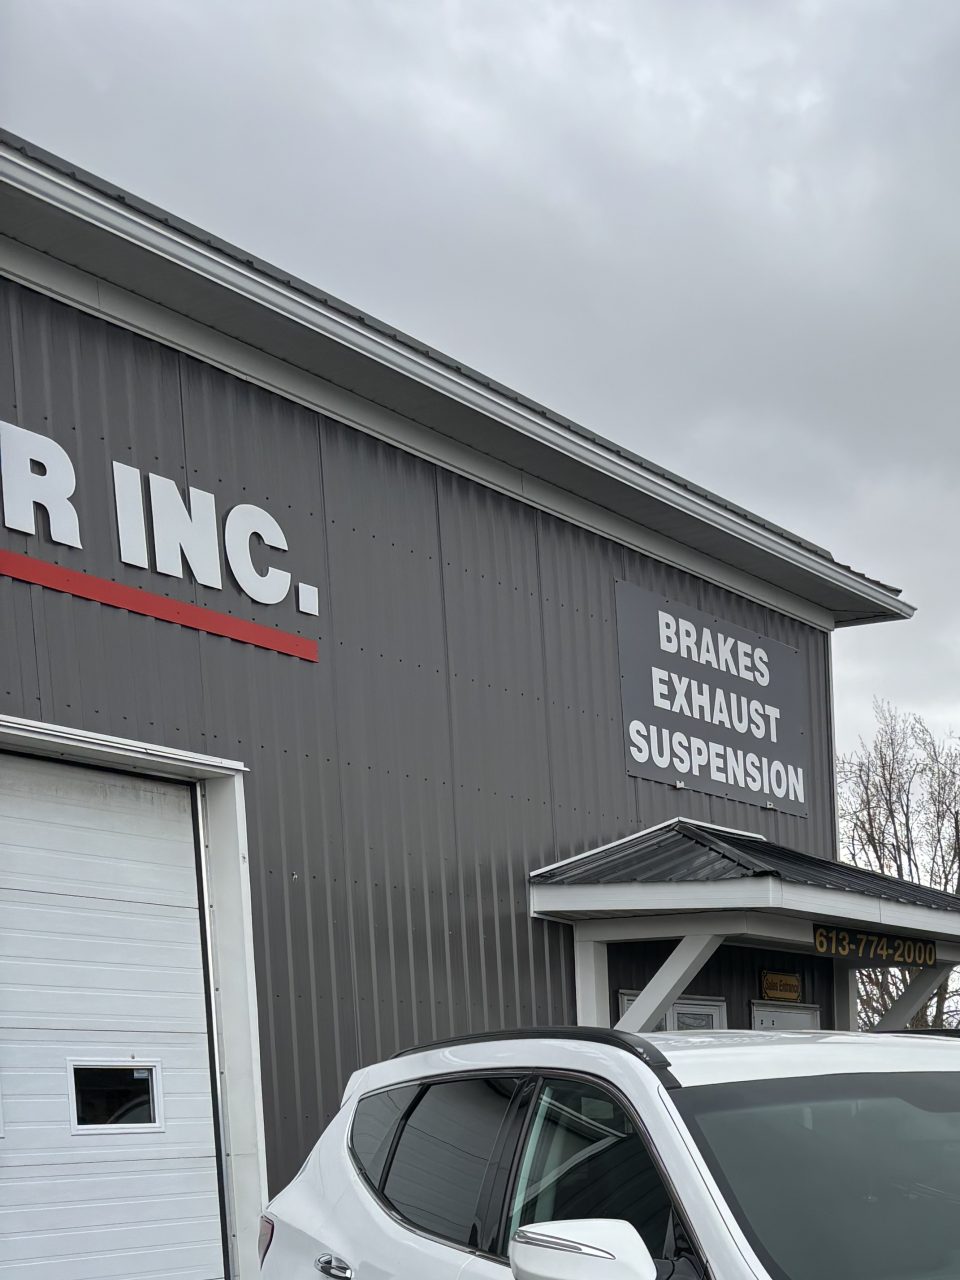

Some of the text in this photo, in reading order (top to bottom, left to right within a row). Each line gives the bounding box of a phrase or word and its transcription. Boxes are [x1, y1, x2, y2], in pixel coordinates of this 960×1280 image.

[0, 420, 319, 616] R INC.
[658, 610, 770, 687] BRAKES
[651, 667, 780, 743] EXHAUST
[628, 720, 805, 803] SUSPENSION
[815, 928, 936, 965] 613-774-2000
